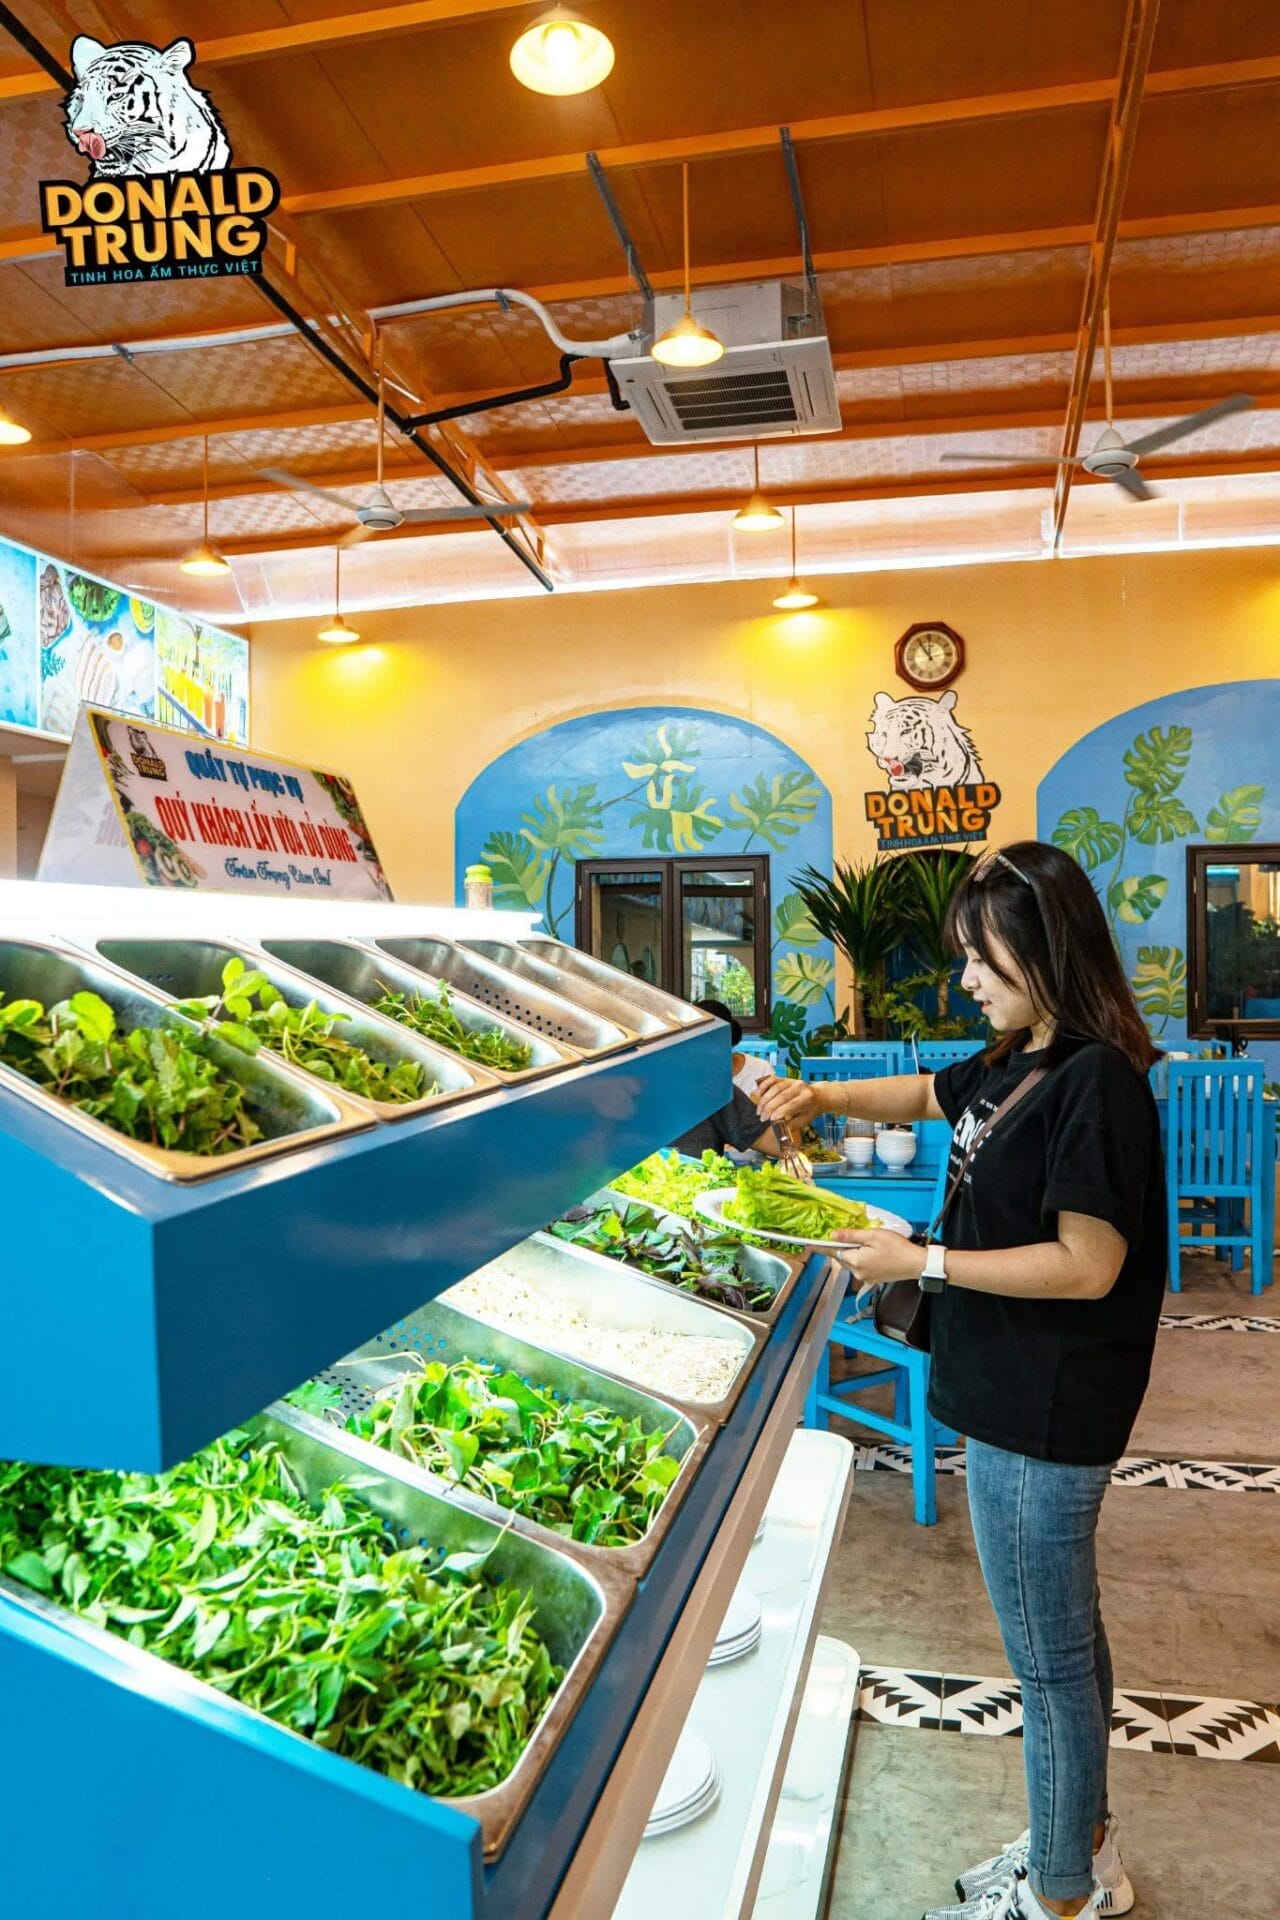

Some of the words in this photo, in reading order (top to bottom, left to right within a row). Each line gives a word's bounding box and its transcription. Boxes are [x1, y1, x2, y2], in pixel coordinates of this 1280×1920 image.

[154, 791, 195, 844] QUÝ
[190, 797, 251, 848] KHÁCH
[867, 784, 997, 821] DONALD
[877, 808, 985, 839] TRUNG
